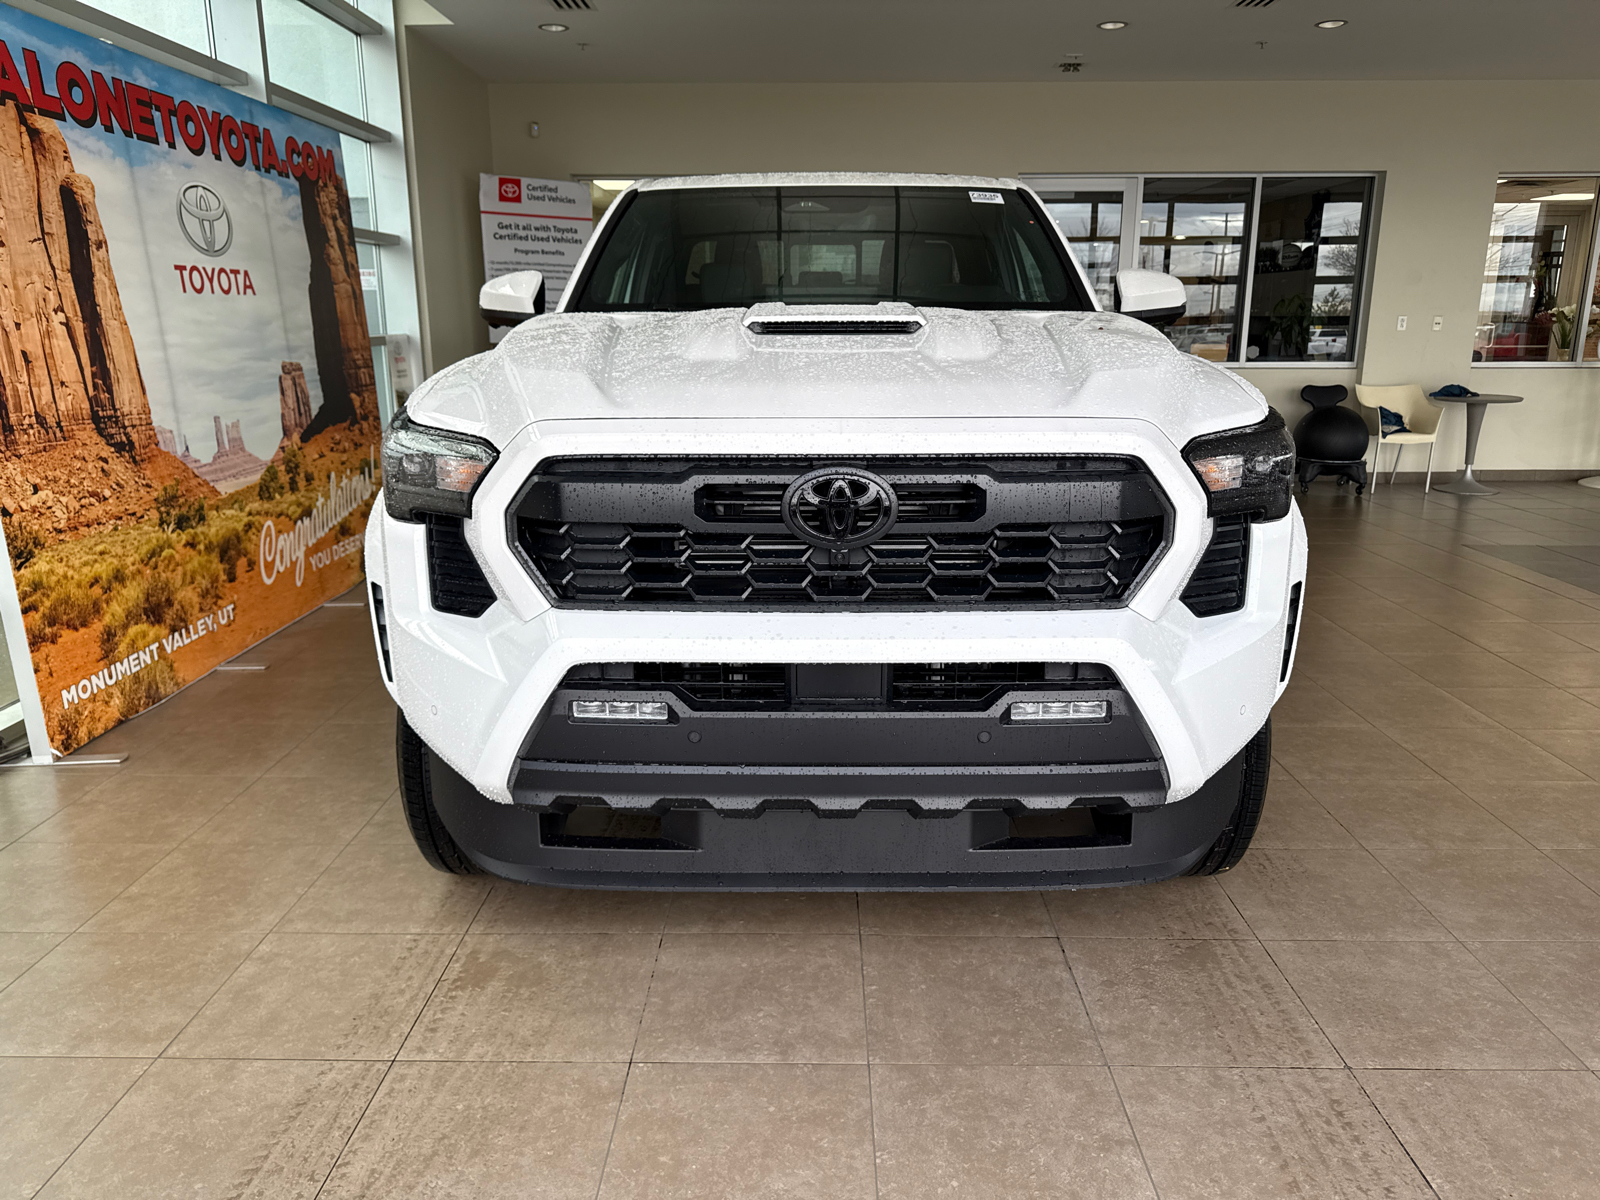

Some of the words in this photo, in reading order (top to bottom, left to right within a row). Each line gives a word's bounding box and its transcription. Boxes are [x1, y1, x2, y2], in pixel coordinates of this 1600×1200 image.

[526, 183, 558, 194] Certified
[526, 193, 545, 202] Used
[546, 195, 576, 205] Vehicles
[497, 222, 512, 231] Get
[514, 223, 520, 231] it
[521, 224, 532, 232] all
[534, 224, 551, 232] with
[552, 225, 578, 236] Toyota
[493, 232, 529, 241] Certified
[530, 234, 550, 243] Used
[551, 236, 582, 245] Vehicles
[514, 247, 540, 256] Program
[173, 264, 256, 296] TOYOTA
[260, 443, 375, 587] Congratulations!
[309, 548, 332, 572] YOU
[60, 641, 160, 710] MONUMENT
[161, 613, 218, 655] VALLEY,
[217, 603, 236, 626] UT
